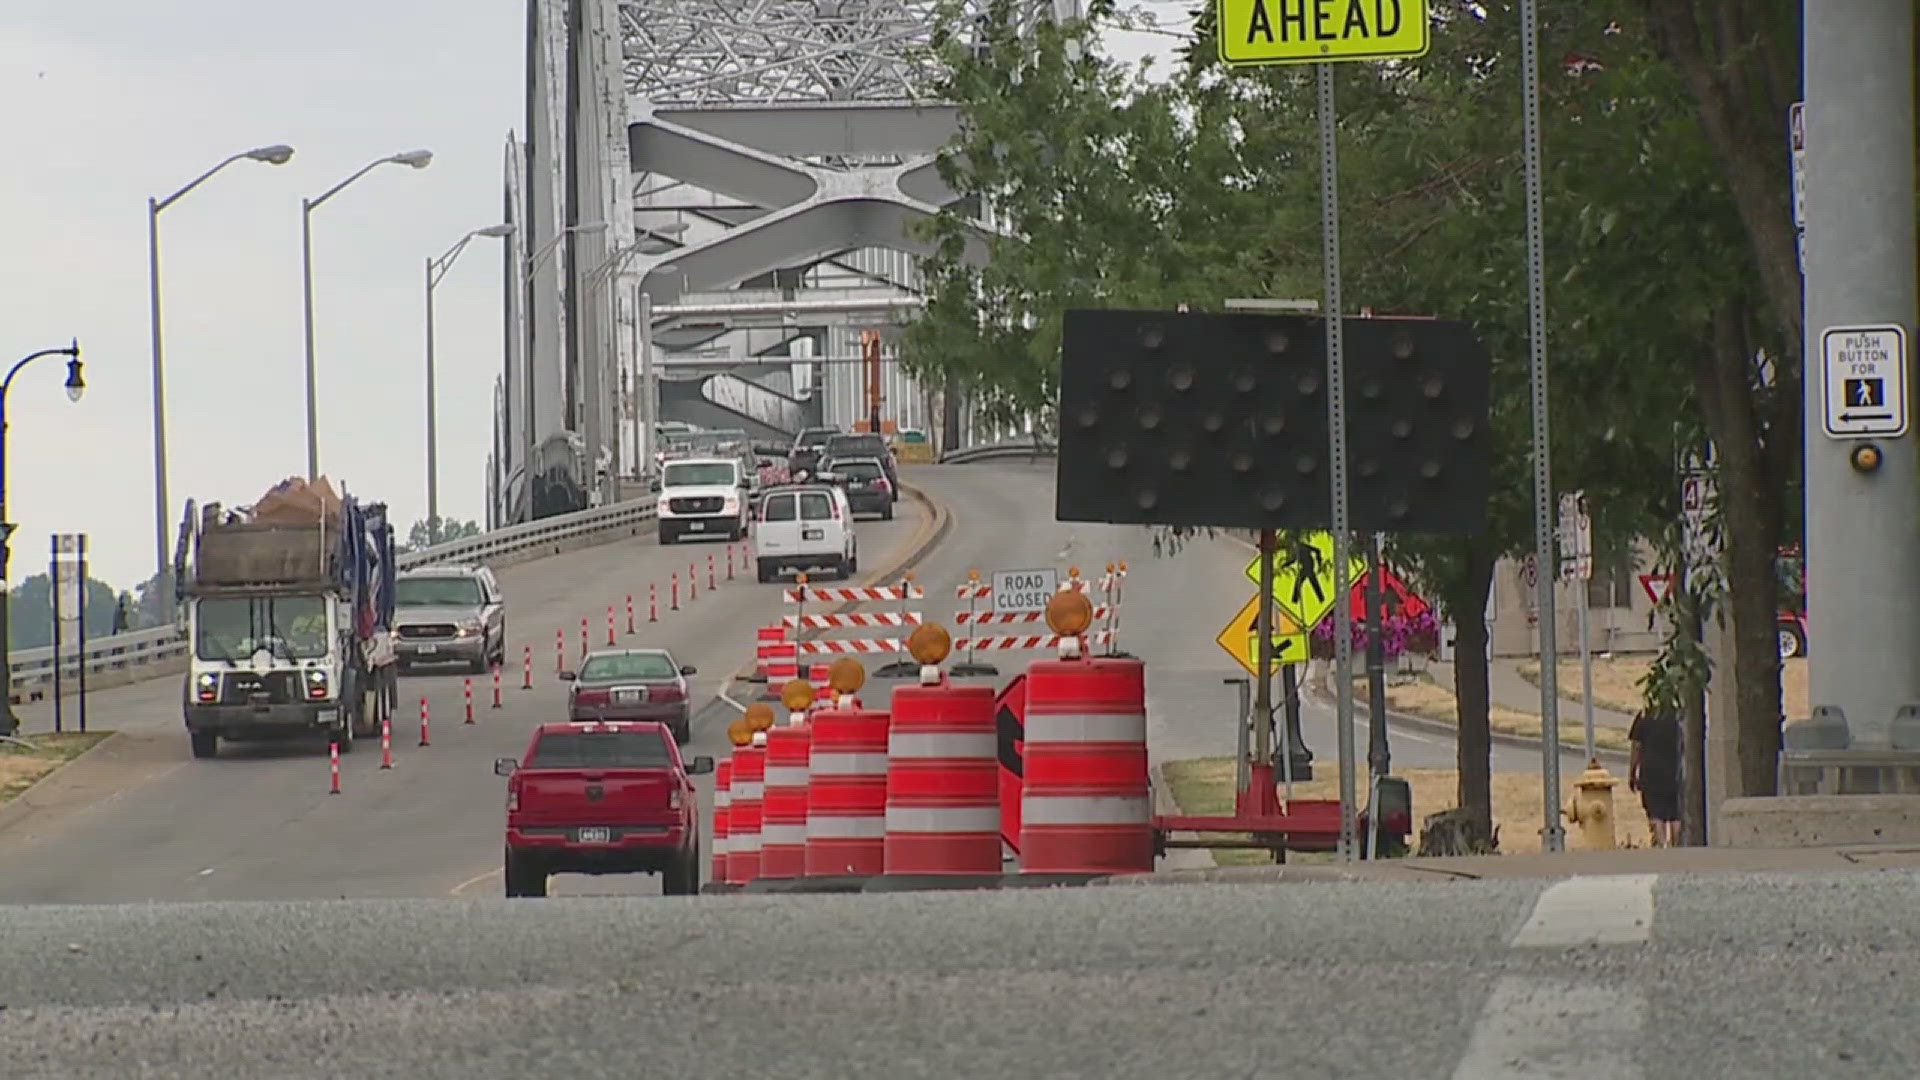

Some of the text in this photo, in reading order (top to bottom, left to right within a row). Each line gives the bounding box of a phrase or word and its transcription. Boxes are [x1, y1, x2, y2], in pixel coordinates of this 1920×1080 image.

[1247, 0, 1401, 43] AHEAD
[1846, 338, 1880, 348] PUSH
[1838, 350, 1888, 361] BUTTON
[1851, 364, 1876, 374] FOR
[1005, 575, 1043, 590] ROAD
[998, 592, 1052, 608] CLOSED
